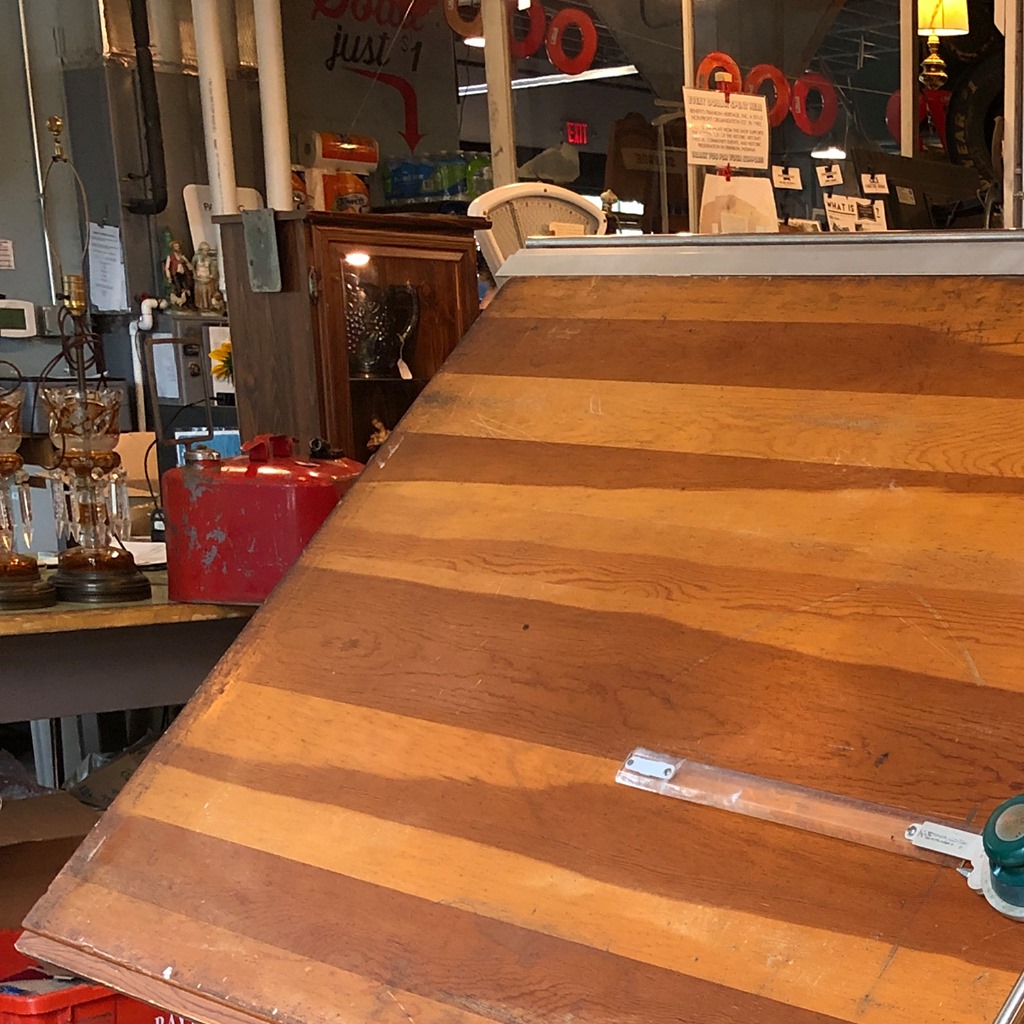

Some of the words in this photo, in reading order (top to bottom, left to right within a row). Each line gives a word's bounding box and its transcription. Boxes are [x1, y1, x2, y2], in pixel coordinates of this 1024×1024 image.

[325, 24, 390, 71] just
[565, 121, 589, 145] EXIT
[827, 201, 846, 211] WHAT
[848, 204, 855, 212] IS
